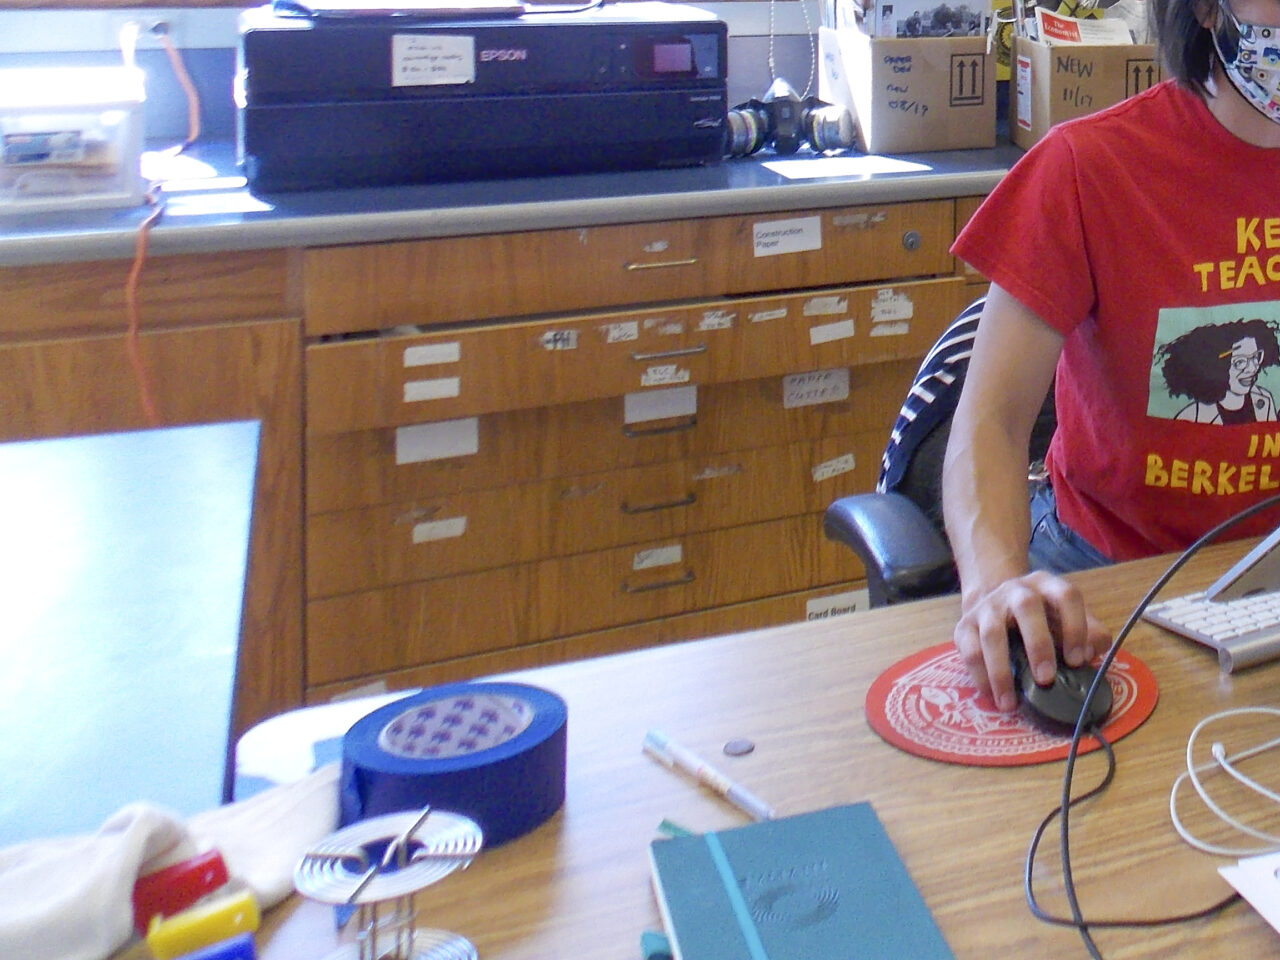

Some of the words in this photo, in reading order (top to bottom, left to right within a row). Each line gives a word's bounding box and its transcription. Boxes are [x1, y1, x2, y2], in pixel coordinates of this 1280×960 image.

[1052, 19, 1065, 30] The
[1044, 23, 1079, 40] Economist
[480, 49, 527, 62] EPSON
[1056, 55, 1094, 78] NEW
[755, 227, 804, 240] Construction
[756, 239, 780, 249] Paper
[808, 608, 829, 621] Card
[830, 602, 856, 617] Board
